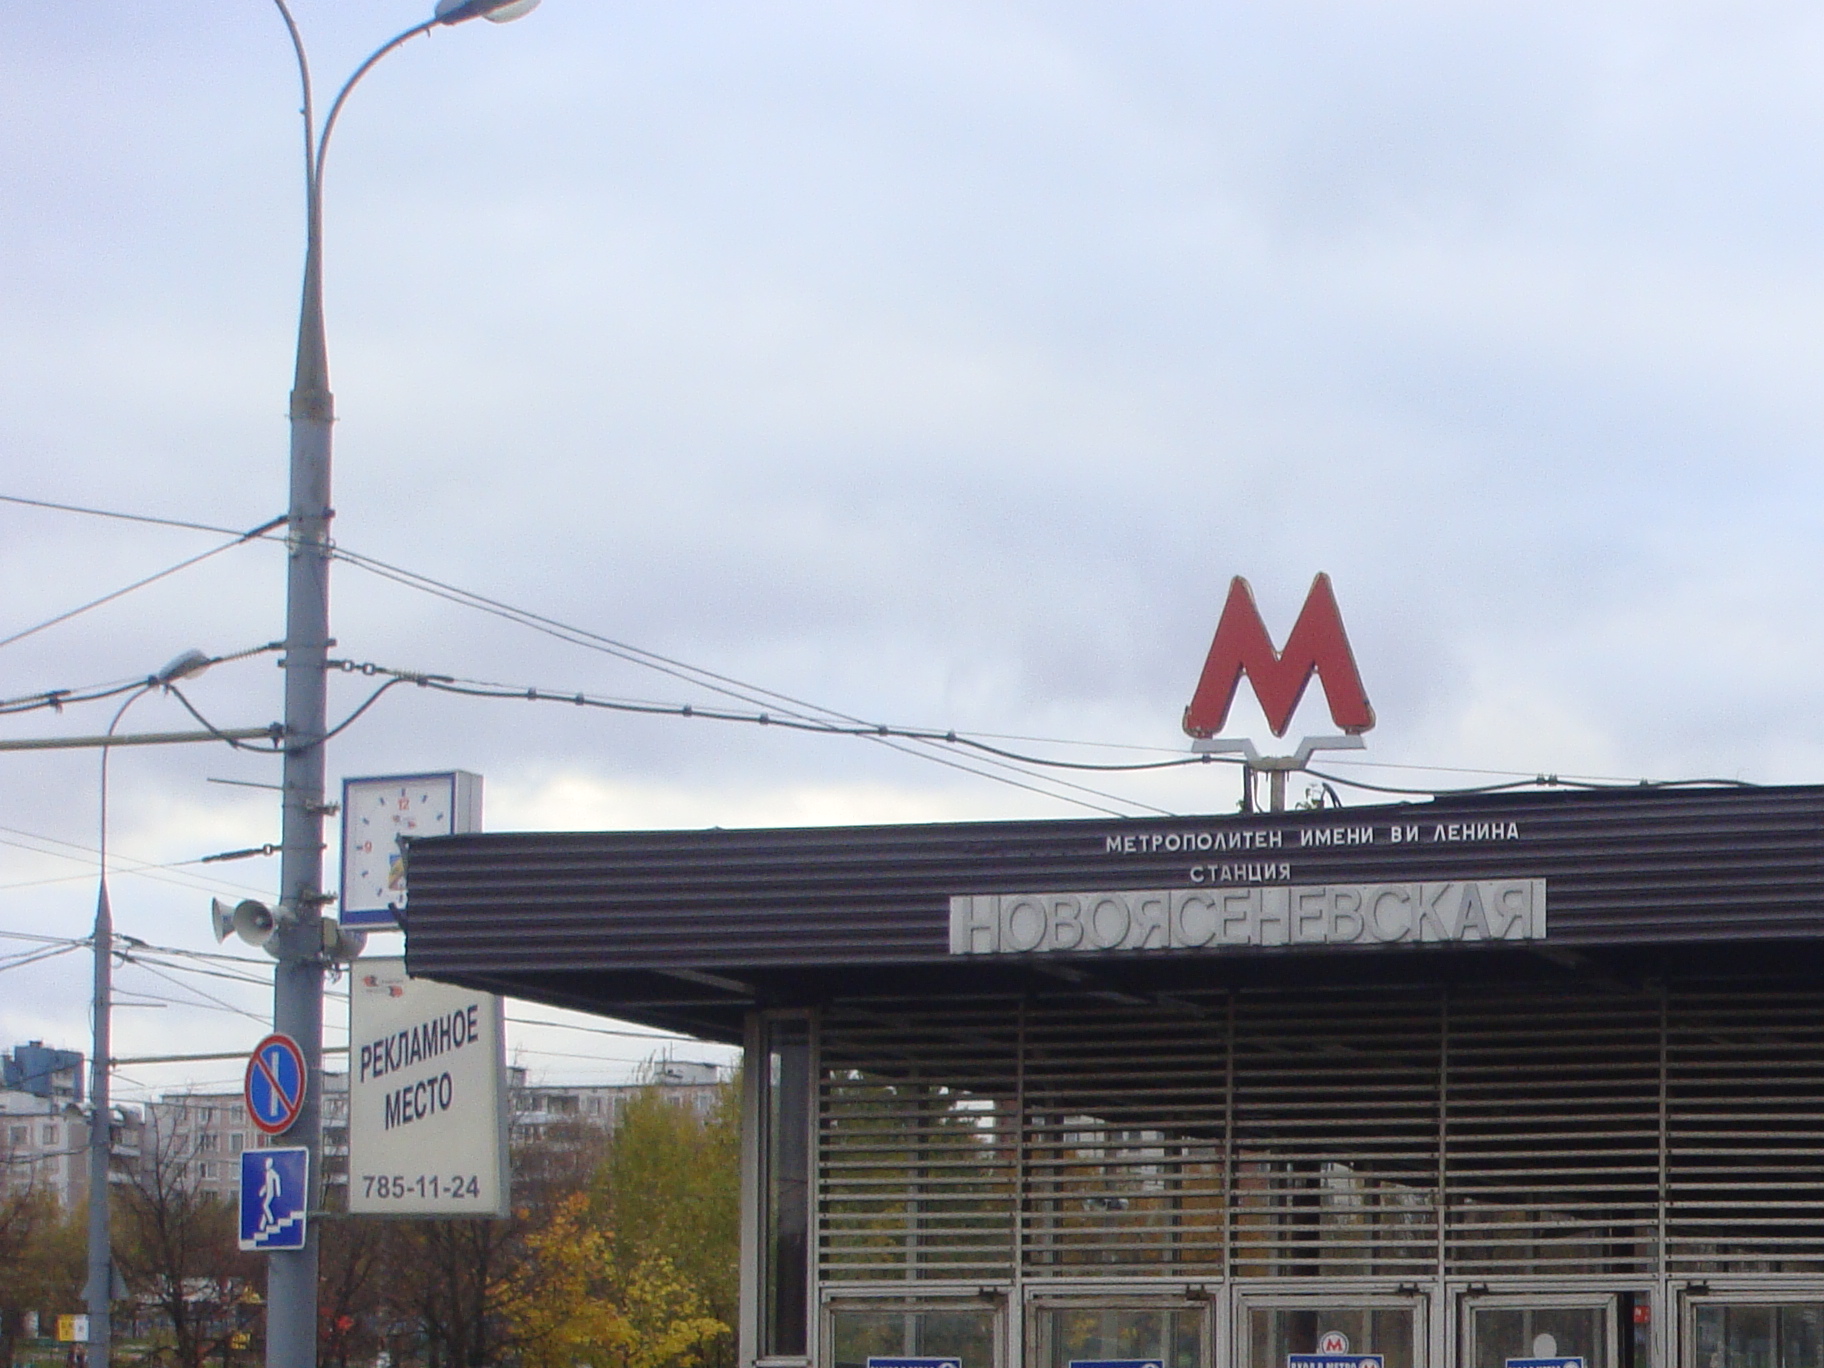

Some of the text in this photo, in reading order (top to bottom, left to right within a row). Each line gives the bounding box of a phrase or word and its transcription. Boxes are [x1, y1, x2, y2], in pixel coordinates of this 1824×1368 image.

[1182, 572, 1376, 738] М
[398, 797, 410, 810] 12
[1105, 821, 1520, 853] МЕТРОПОЛИТЕН ИМЕНИ ВИ ЛЕНИНА
[1189, 862, 1292, 883] СТАНЦИЯ
[960, 881, 1533, 954] НОВОЯСЕНЕВСКАЯ
[360, 1004, 479, 1083] РЕКЛАМНОЕ
[385, 1071, 453, 1131] МЕСТО
[362, 1174, 481, 1199] 785-11-24
[1325, 1338, 1343, 1352] М
